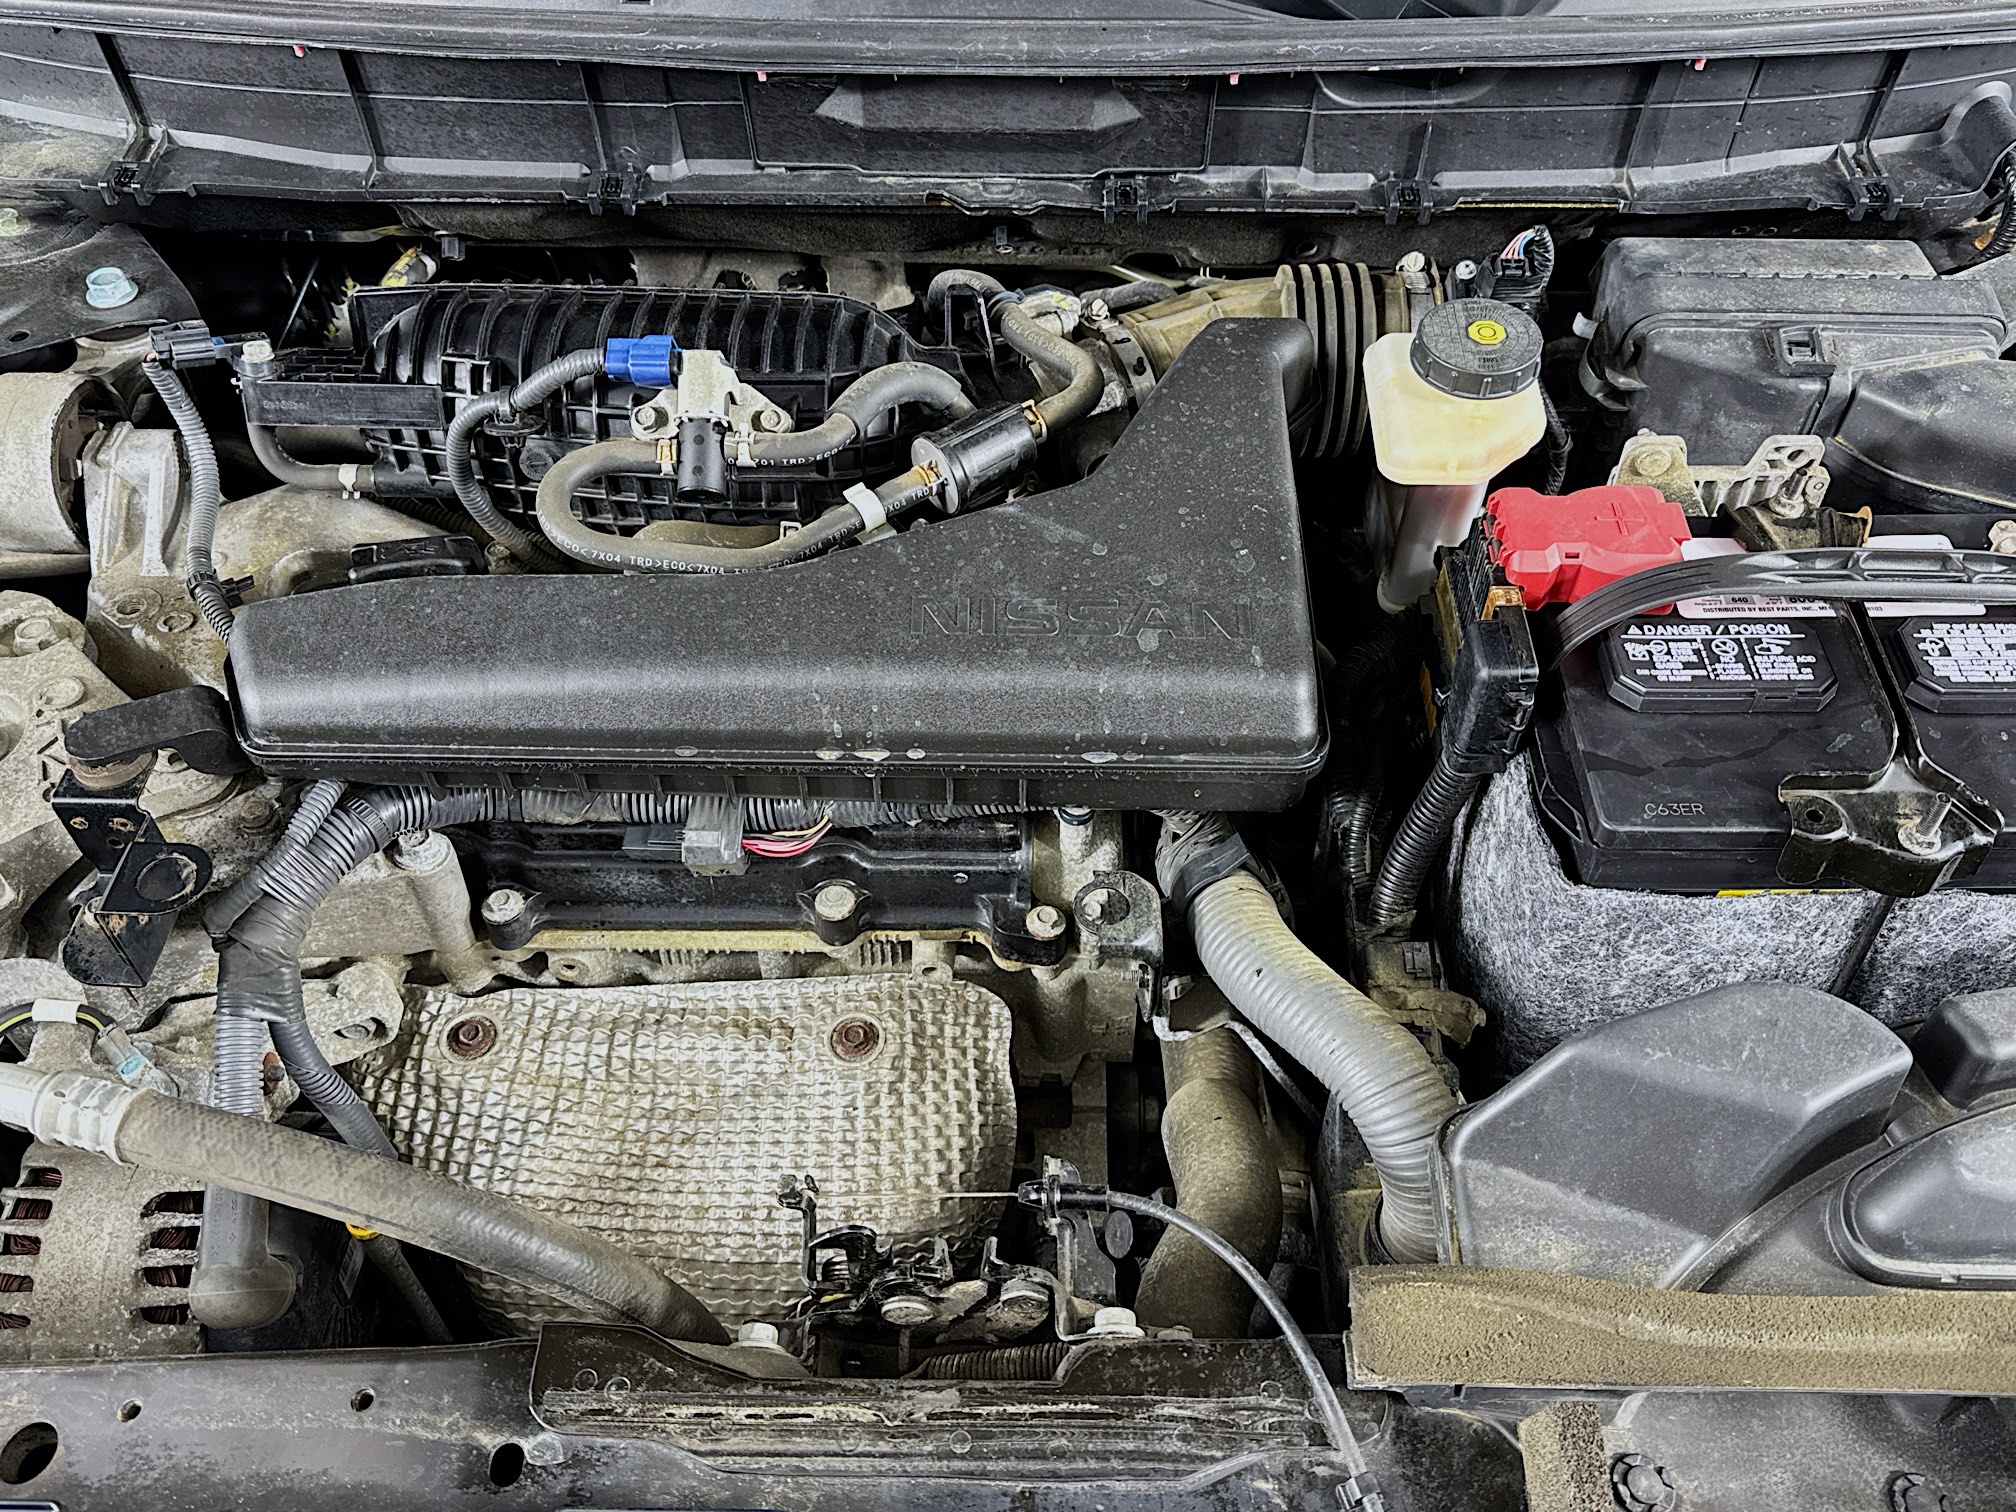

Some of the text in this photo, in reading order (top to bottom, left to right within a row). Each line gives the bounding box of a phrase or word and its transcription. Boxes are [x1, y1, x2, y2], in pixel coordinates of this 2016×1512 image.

[909, 596, 1253, 641] NISSAN
[1643, 624, 1712, 635] DANGER
[1727, 623, 1791, 635] POISON
